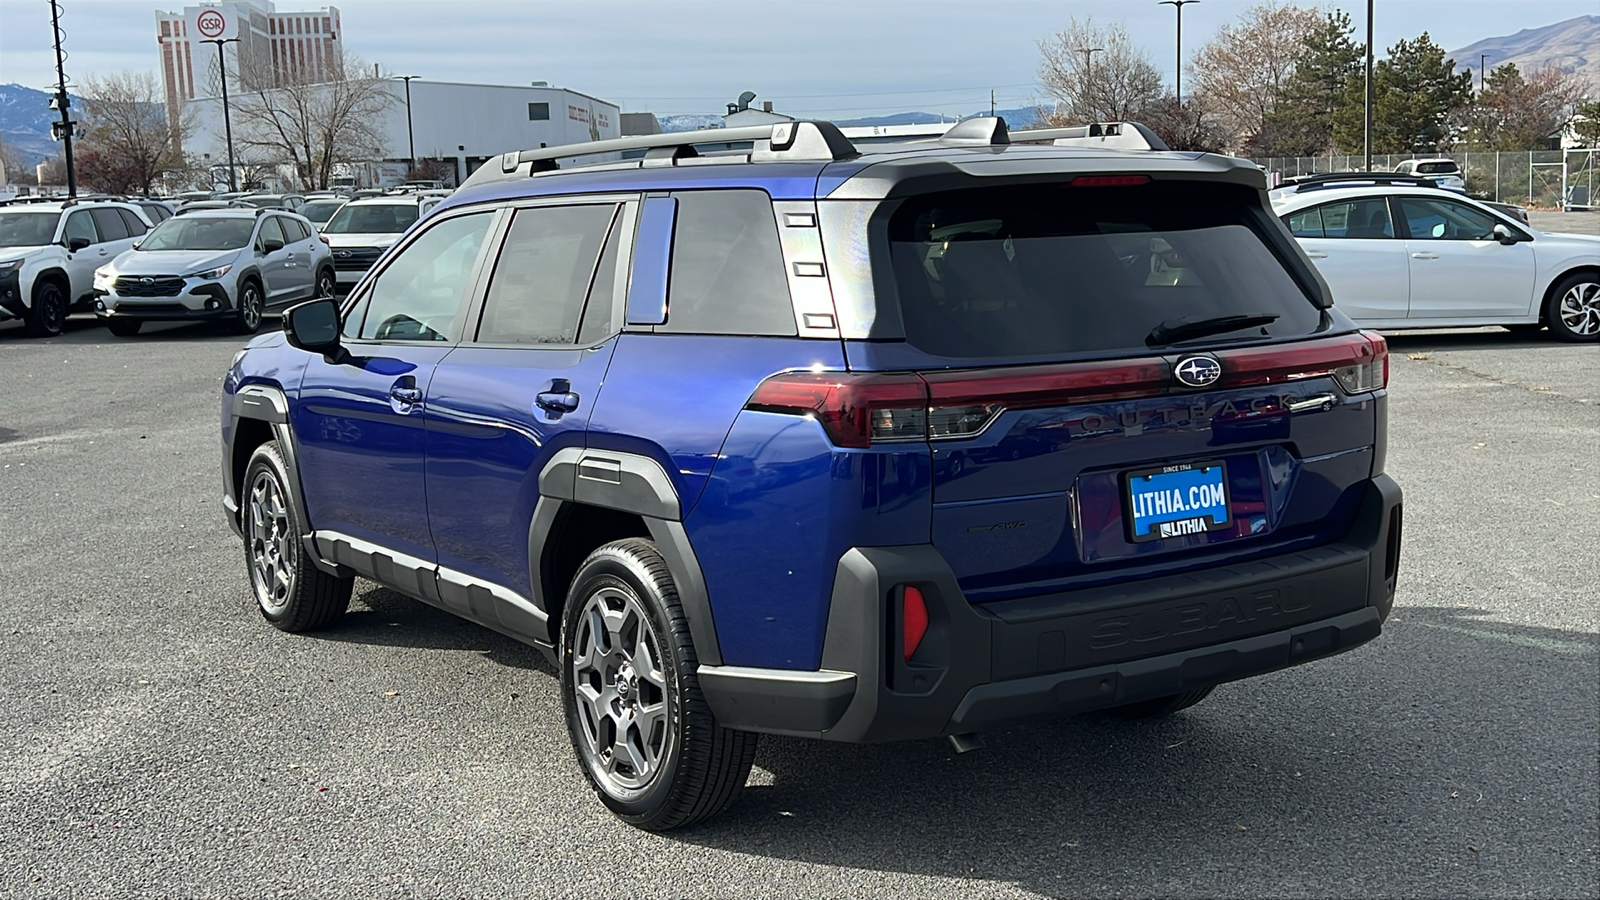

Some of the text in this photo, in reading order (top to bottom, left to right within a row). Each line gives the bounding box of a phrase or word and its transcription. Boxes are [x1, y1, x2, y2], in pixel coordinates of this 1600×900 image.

[201, 18, 221, 30] GSR
[1081, 394, 1293, 432] OUTBACK
[1163, 465, 1179, 473] SINCE
[1132, 482, 1226, 518] LITHIA.COM
[1170, 517, 1208, 536] LITHIA
[1090, 583, 1314, 649] SUBARU
